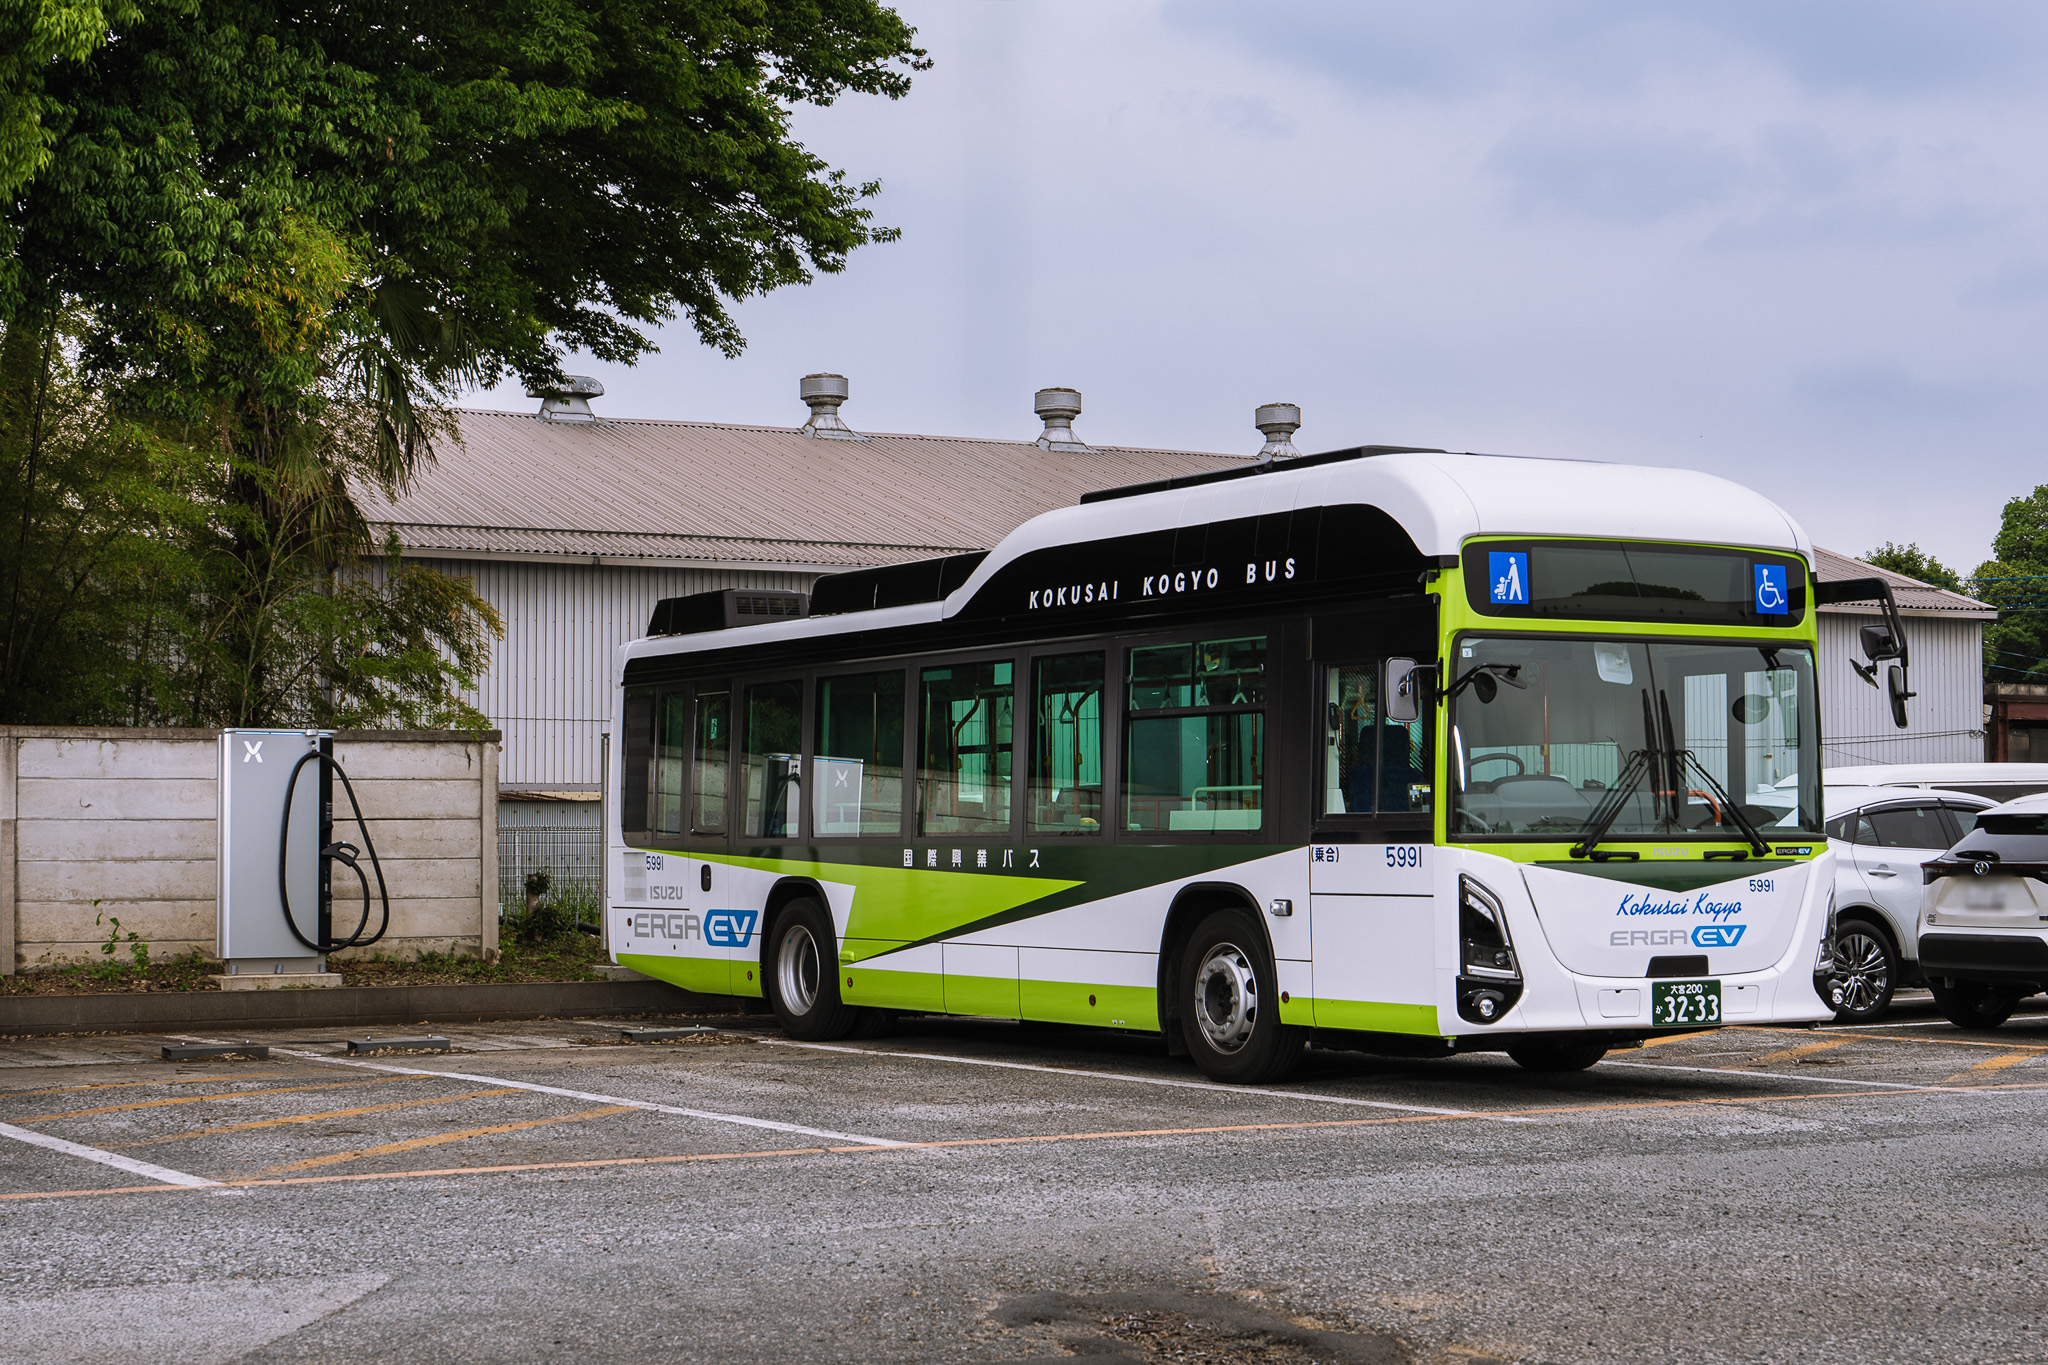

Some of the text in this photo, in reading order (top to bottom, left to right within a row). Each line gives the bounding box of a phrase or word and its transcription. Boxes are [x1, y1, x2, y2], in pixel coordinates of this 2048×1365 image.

[1028, 557, 1297, 610] KOKUSAI KOGYO BUS
[903, 848, 1040, 868] 国際興業バス
[1310, 846, 1340, 863] (乗合)
[1385, 846, 1422, 868] 5991
[1653, 847, 1689, 857] ISUZU
[645, 855, 664, 871] 5991
[649, 885, 683, 900] ISUZU
[1749, 879, 1775, 892] 5991
[1616, 893, 1742, 922] Kokusai Kogyo
[634, 913, 753, 944] ERGA EV
[1609, 927, 1741, 946] ERGA EV
